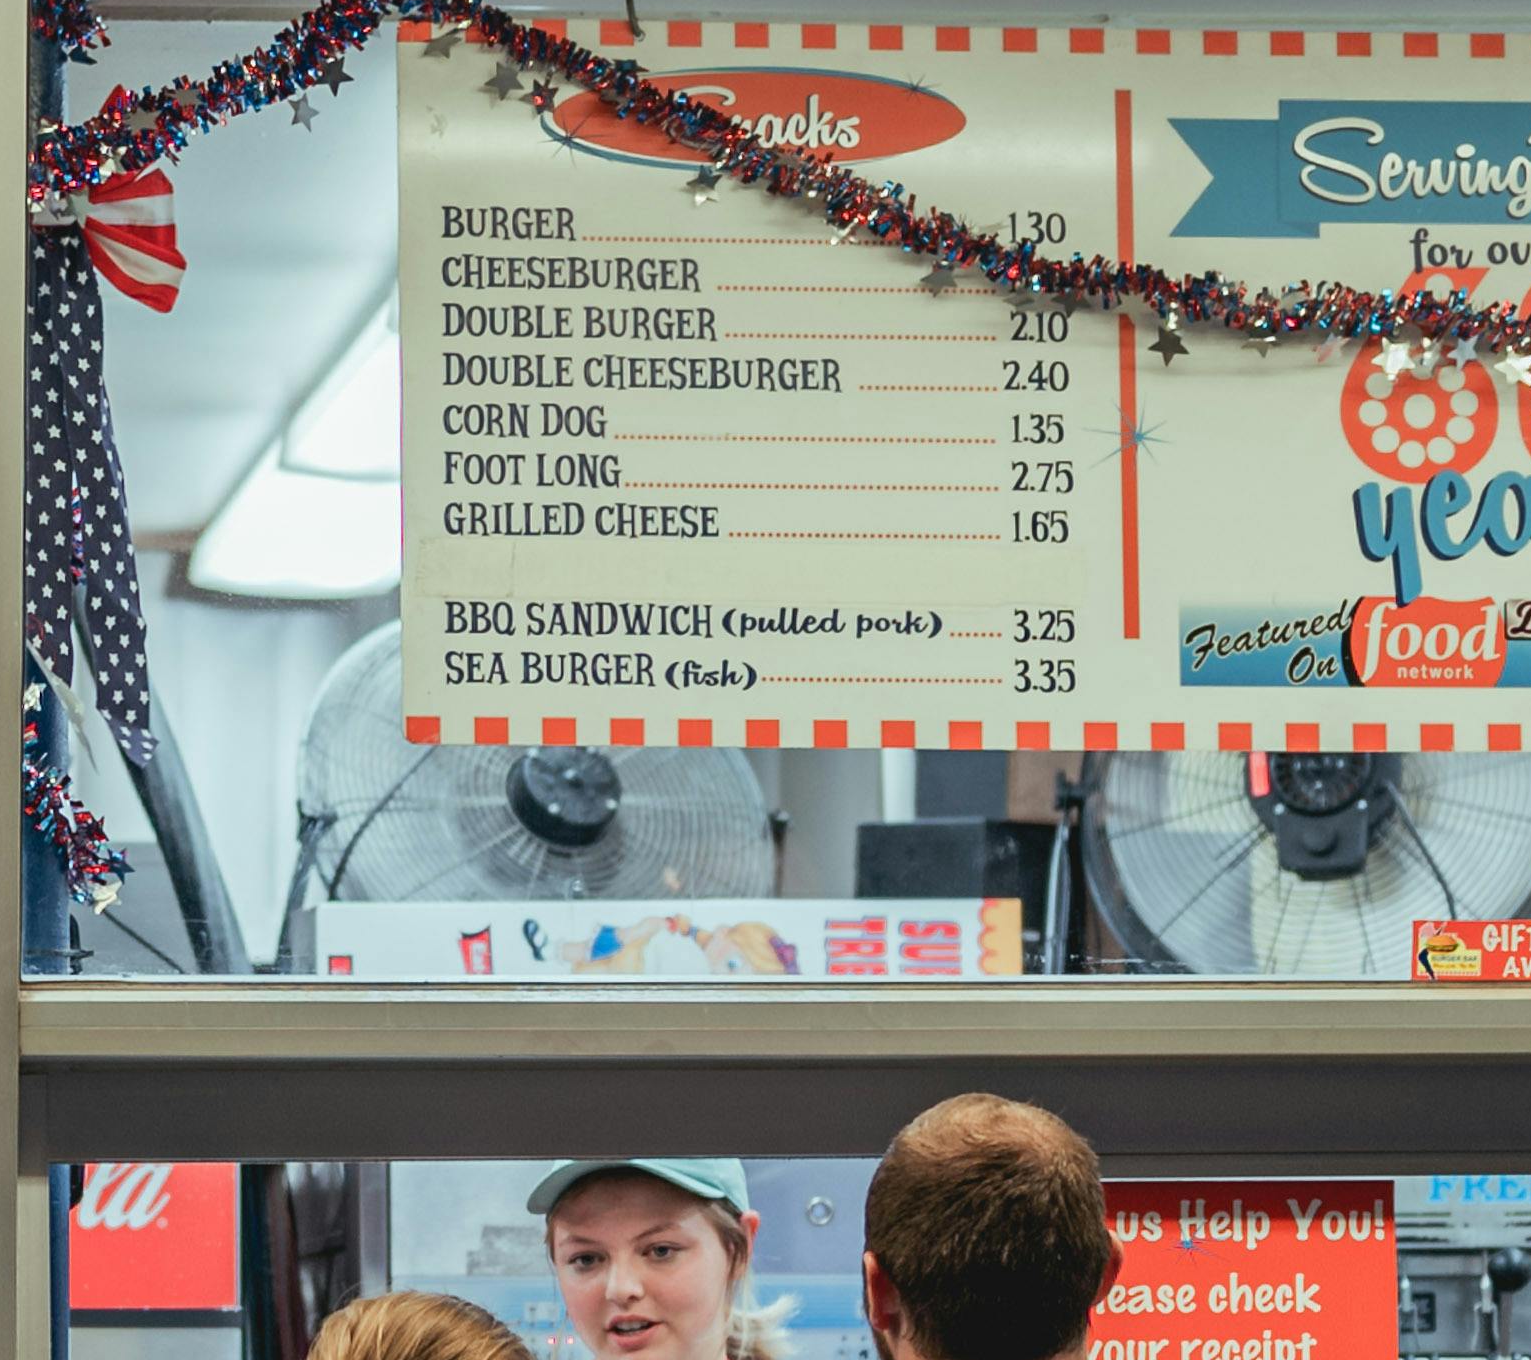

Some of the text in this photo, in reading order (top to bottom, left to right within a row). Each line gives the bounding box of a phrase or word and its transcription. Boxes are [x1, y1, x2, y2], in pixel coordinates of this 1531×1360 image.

[441, 205, 577, 242] BURGER
[1407, 226, 1476, 275] for
[441, 254, 701, 293] CHEESEBURGER
[441, 302, 1071, 343] DOUBLE BURGER 2.10
[442, 352, 1070, 393] DOUBLE CHEESEBURGER 2.40
[442, 402, 1065, 445] CORN DOG 1.35
[443, 450, 1074, 494] FOOT LONG 2.75
[443, 501, 1069, 544] GRILLED CHEESE 1.65
[444, 601, 1075, 643] BBQ SANDWICH (pulled pork) 3.25
[1183, 598, 1355, 670] Featured
[1362, 605, 1501, 682] food
[444, 650, 1076, 693] SEA BURGER (fish) 3.35
[1286, 646, 1339, 685] On
[1397, 664, 1475, 681] network
[1116, 1198, 1386, 1251] us Help You!
[1208, 1271, 1322, 1314] check
